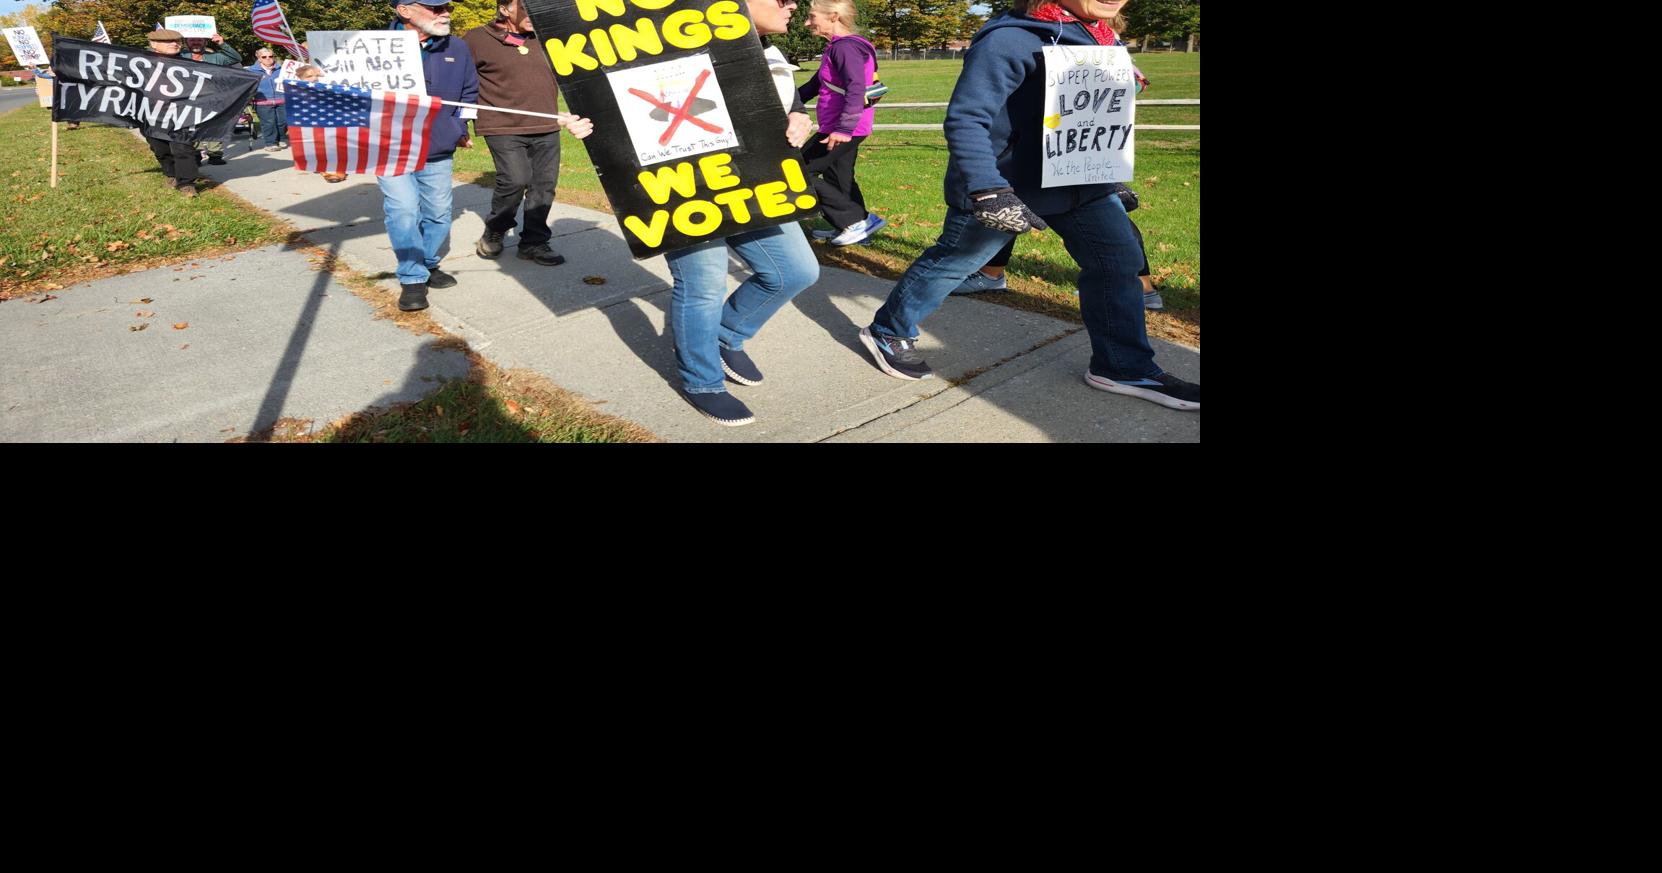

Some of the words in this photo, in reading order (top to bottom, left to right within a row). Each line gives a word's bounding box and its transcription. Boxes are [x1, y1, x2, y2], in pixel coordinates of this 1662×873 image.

[333, 37, 405, 55] HATE
[545, 1, 751, 76] KINGS
[78, 49, 213, 101] RESIST
[365, 56, 405, 72] Not
[385, 73, 417, 90] US
[1048, 69, 1090, 89] SUPER
[58, 80, 218, 132] TYRANNY
[1059, 87, 1127, 117] LOVE
[1077, 117, 1096, 128] and
[640, 152, 657, 161] Can
[671, 143, 697, 154] Trust
[698, 139, 716, 150] This
[1045, 123, 1133, 159] LIBERTY
[637, 153, 741, 205] WE
[1051, 160, 1064, 177] We
[1065, 159, 1081, 175] the
[623, 158, 817, 248] VOTE!
